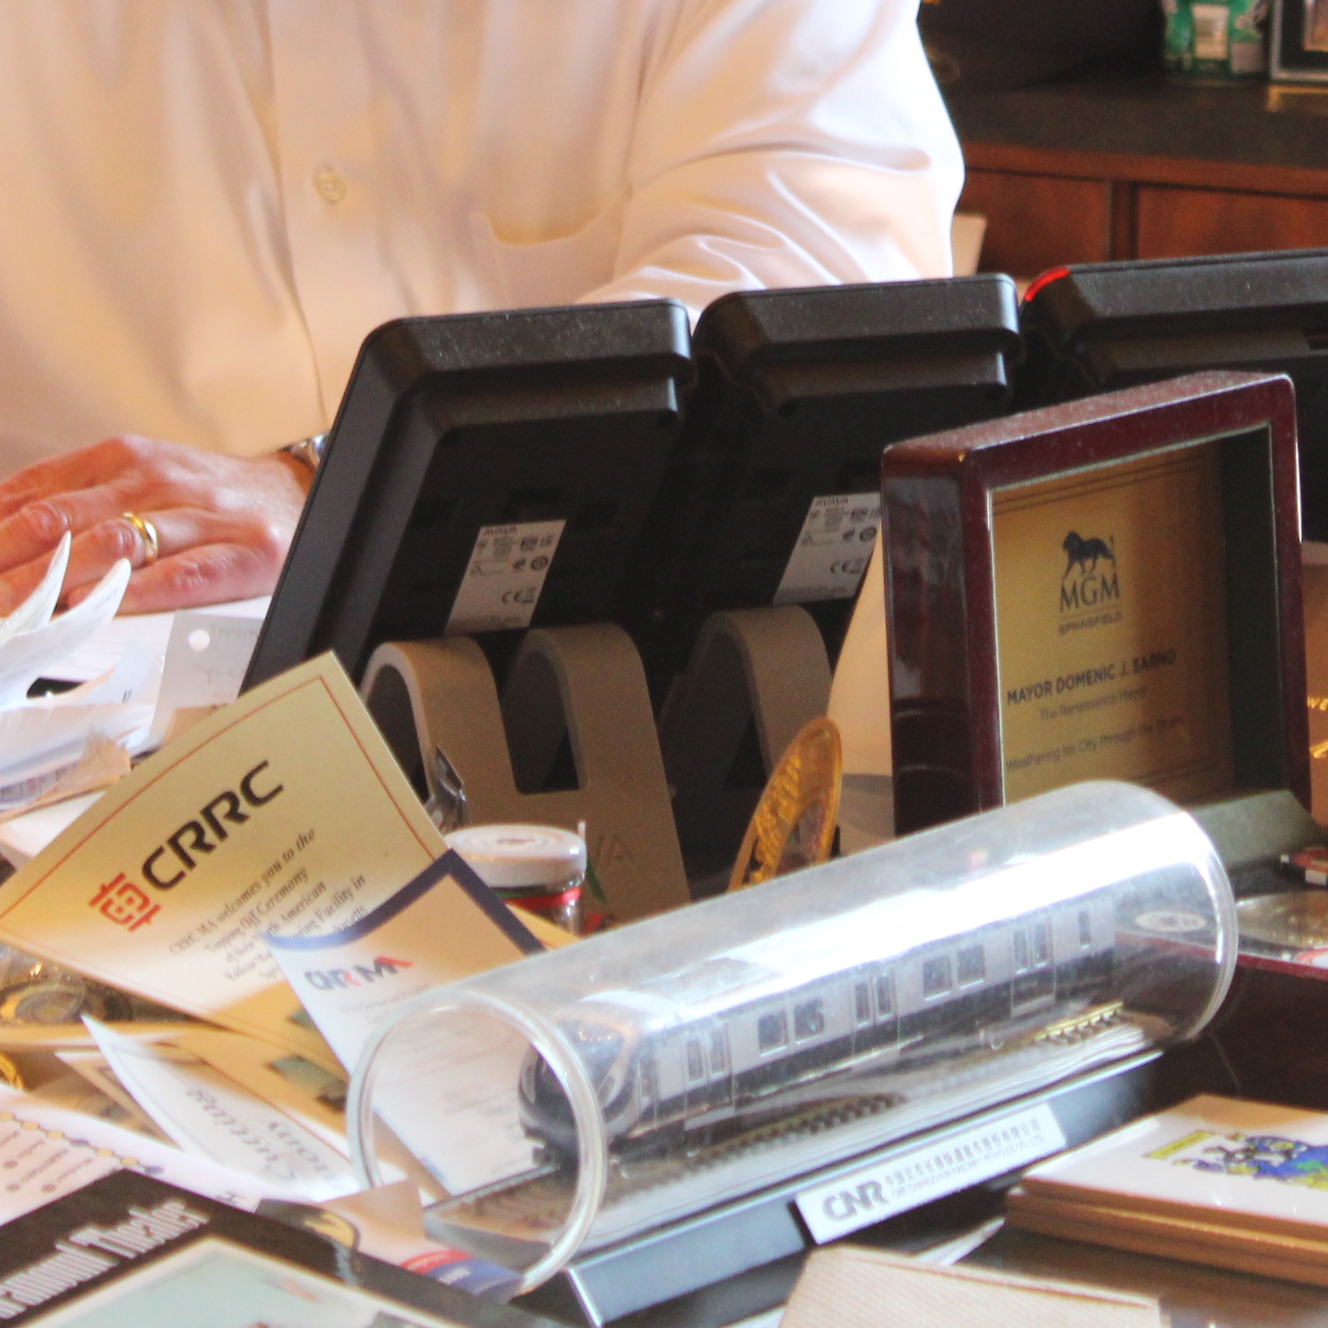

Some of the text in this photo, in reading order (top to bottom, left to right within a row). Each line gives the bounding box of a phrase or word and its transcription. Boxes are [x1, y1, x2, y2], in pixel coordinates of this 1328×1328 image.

[1059, 573, 1121, 613] MGM
[1058, 610, 1122, 637] SPRINGFIELD
[1007, 648, 1177, 706] MAYOR DOMENIC J. SARNO
[1039, 708, 1058, 721] The
[1078, 738, 1098, 753] City
[141, 759, 285, 892] CRRC
[218, 878, 263, 924] welcomes
[260, 861, 283, 888] you
[281, 849, 296, 866] to
[294, 828, 316, 852] the
[255, 866, 309, 916] Ceremony
[351, 873, 367, 892] in
[280, 880, 328, 928] American
[822, 1179, 890, 1222] CNR
